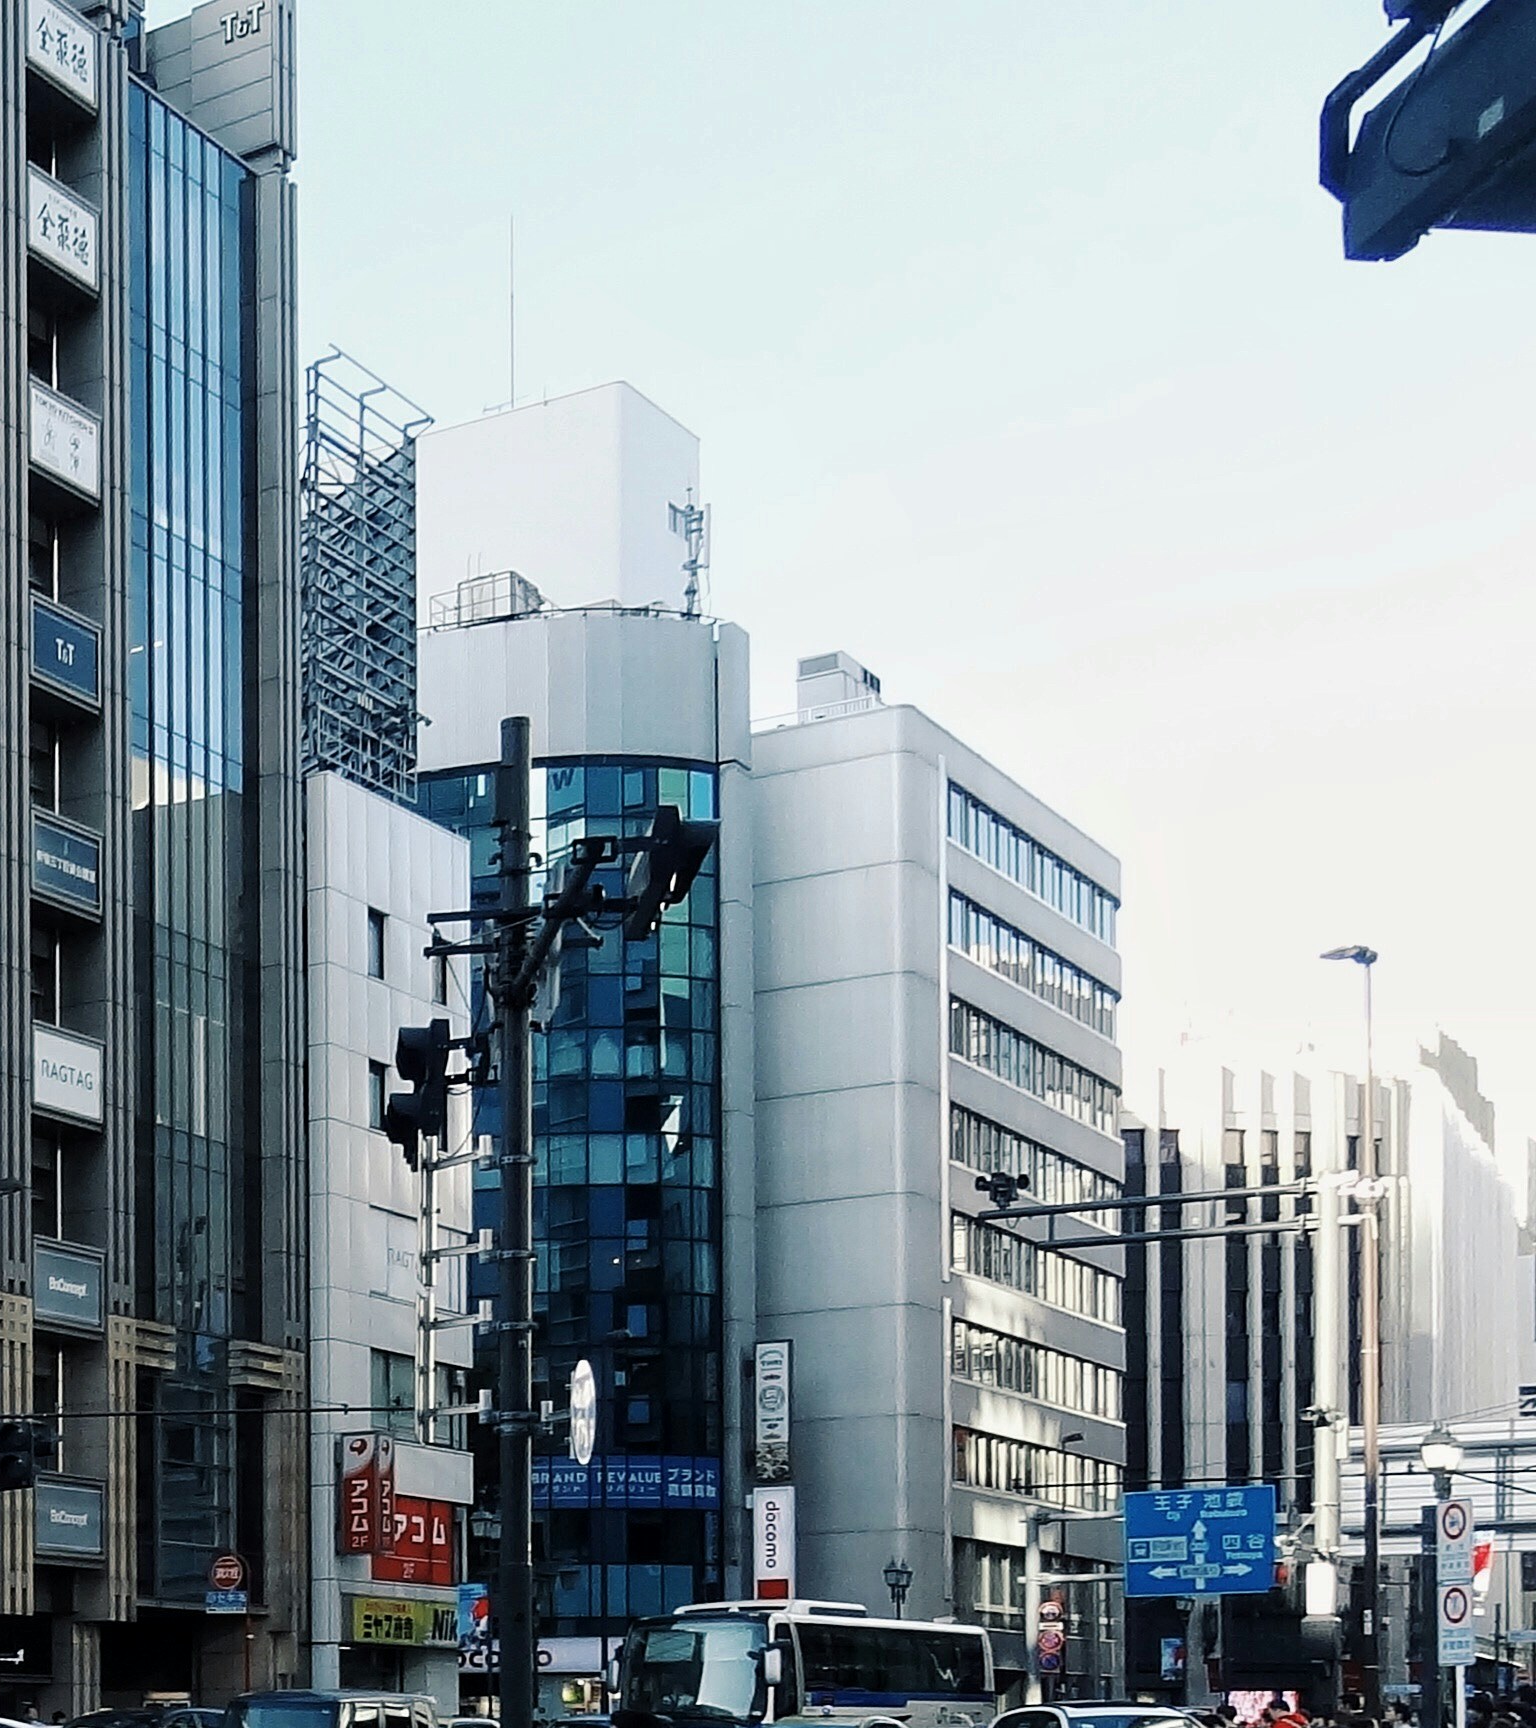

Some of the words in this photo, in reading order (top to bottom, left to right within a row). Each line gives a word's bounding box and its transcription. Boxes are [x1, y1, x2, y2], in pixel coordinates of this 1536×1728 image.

[41, 1057, 94, 1090] RAGTAG
[667, 1468, 716, 1481] ブランド
[350, 1479, 370, 1533] アコム
[1154, 1493, 1194, 1511] 王子
[351, 1536, 369, 1549] 2F
[394, 1513, 447, 1546] アコム
[765, 1501, 780, 1569] docomo
[1222, 1533, 1266, 1550] 四谷
[431, 1607, 458, 1642] Nik
